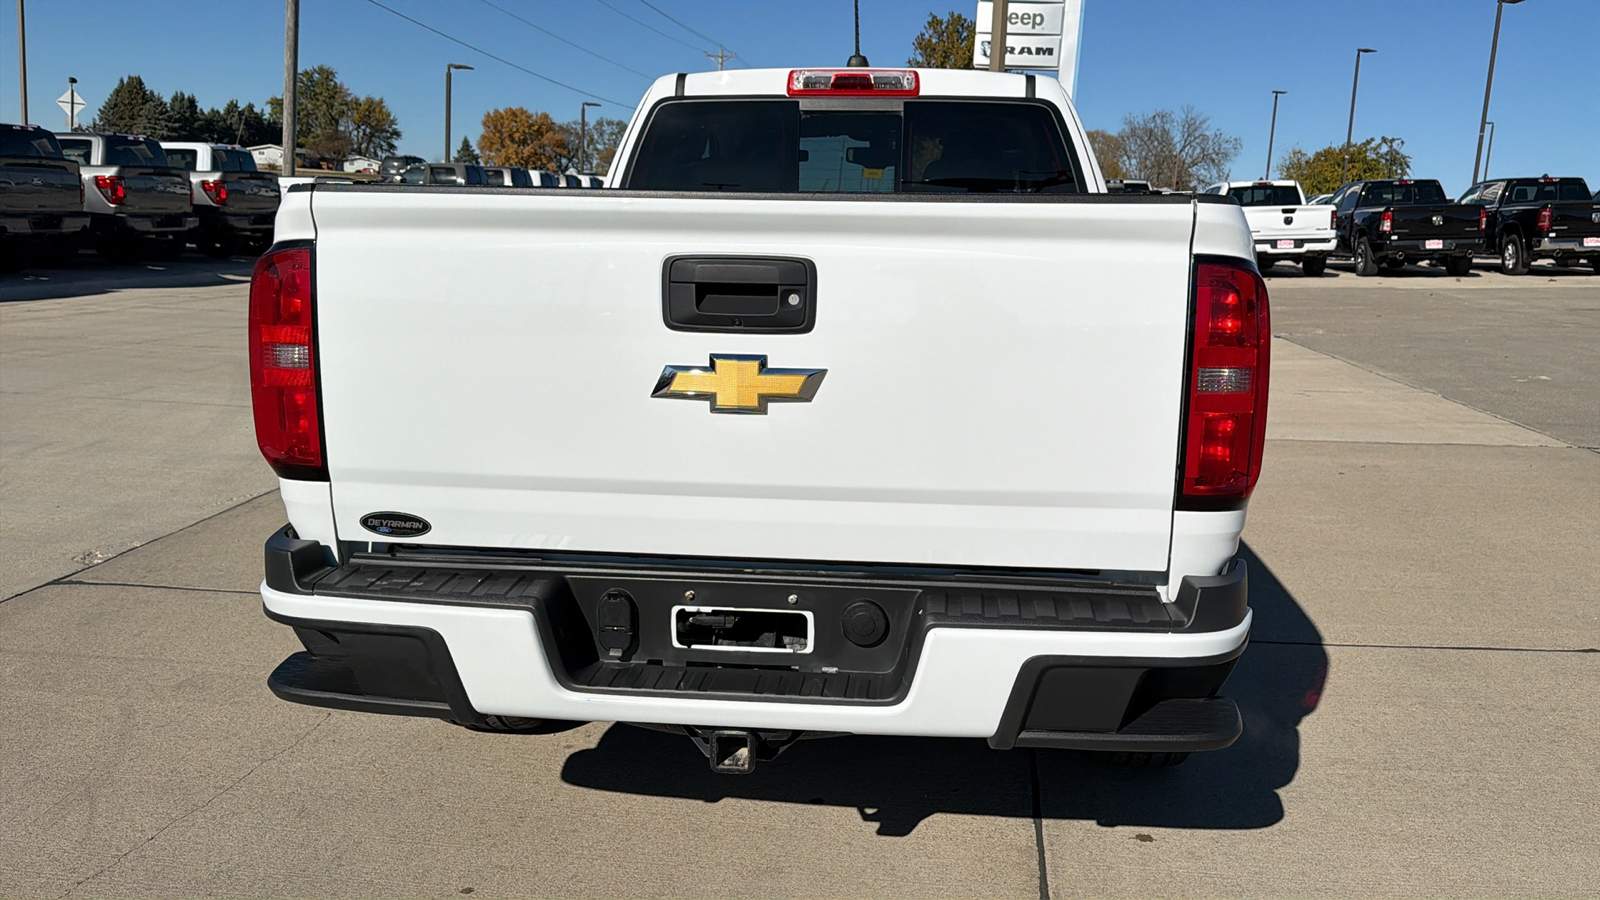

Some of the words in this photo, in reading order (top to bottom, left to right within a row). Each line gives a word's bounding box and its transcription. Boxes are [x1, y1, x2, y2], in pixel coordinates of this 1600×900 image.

[1008, 11, 1045, 30] eep
[1005, 46, 1054, 56] RAM
[367, 518, 423, 529] DEYARMAN
